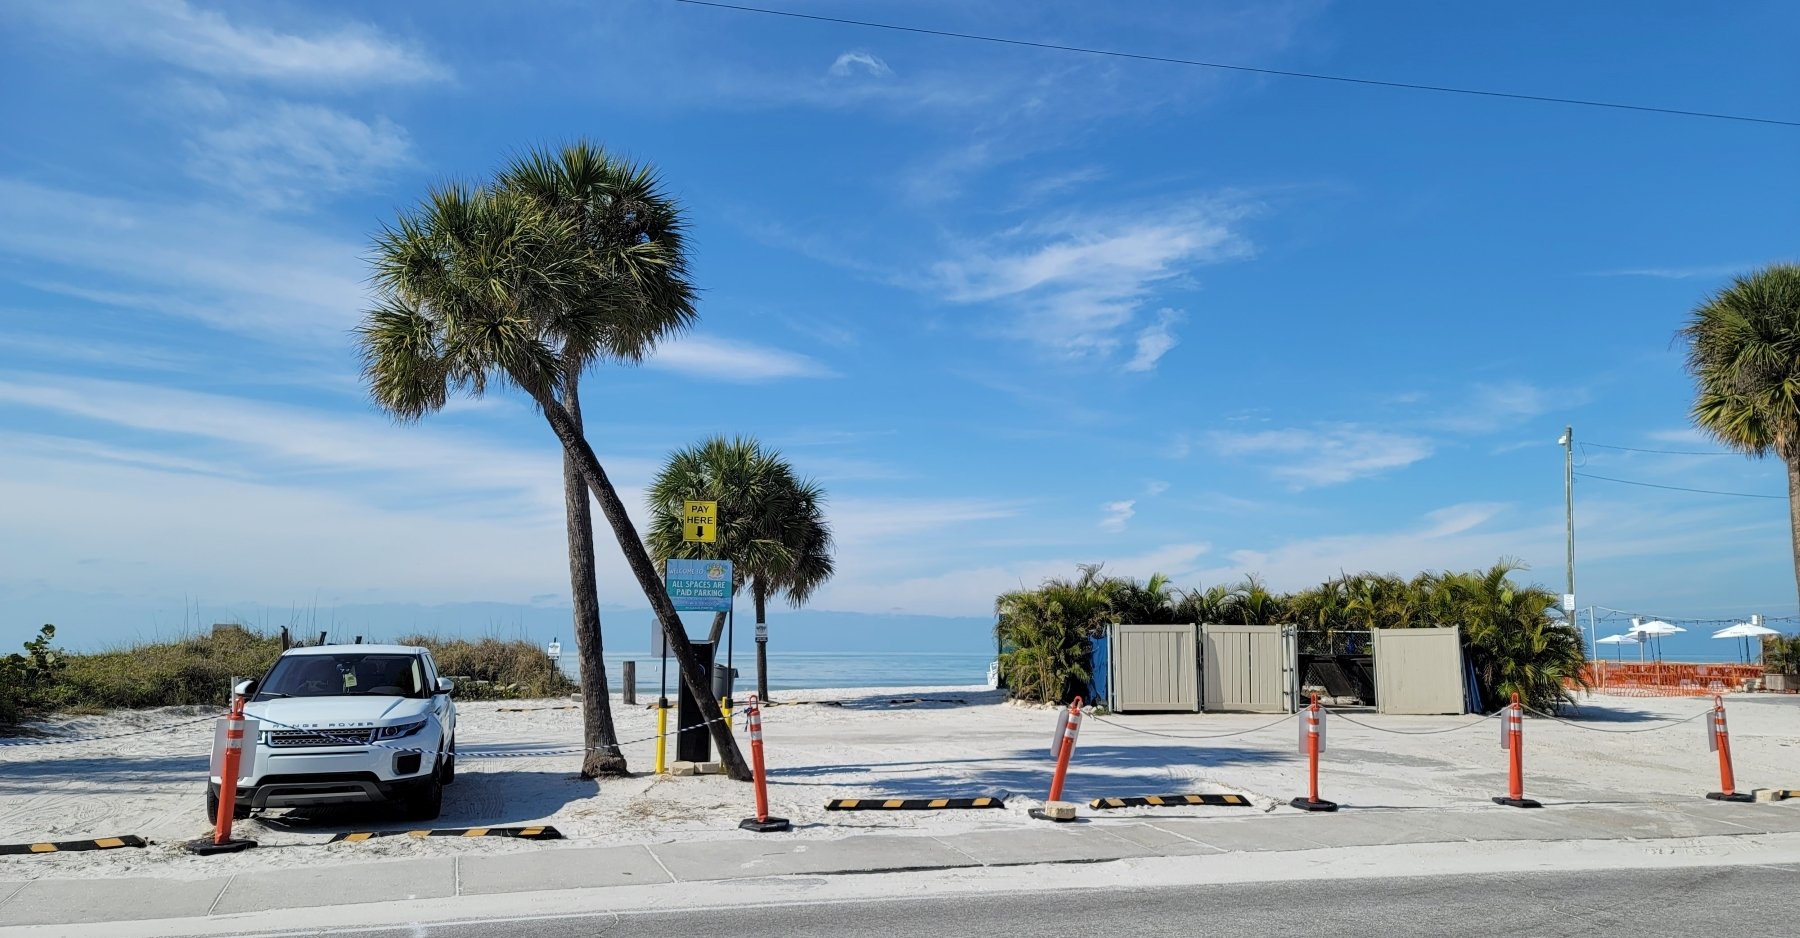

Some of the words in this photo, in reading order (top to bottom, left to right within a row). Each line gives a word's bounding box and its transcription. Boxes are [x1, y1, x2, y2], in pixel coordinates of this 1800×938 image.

[691, 505, 709, 513] PAY
[687, 516, 713, 524] HERE
[672, 580, 683, 588] ALL
[685, 580, 710, 588] SPACES
[676, 588, 692, 596] PAID
[694, 589, 723, 597] PARKING
